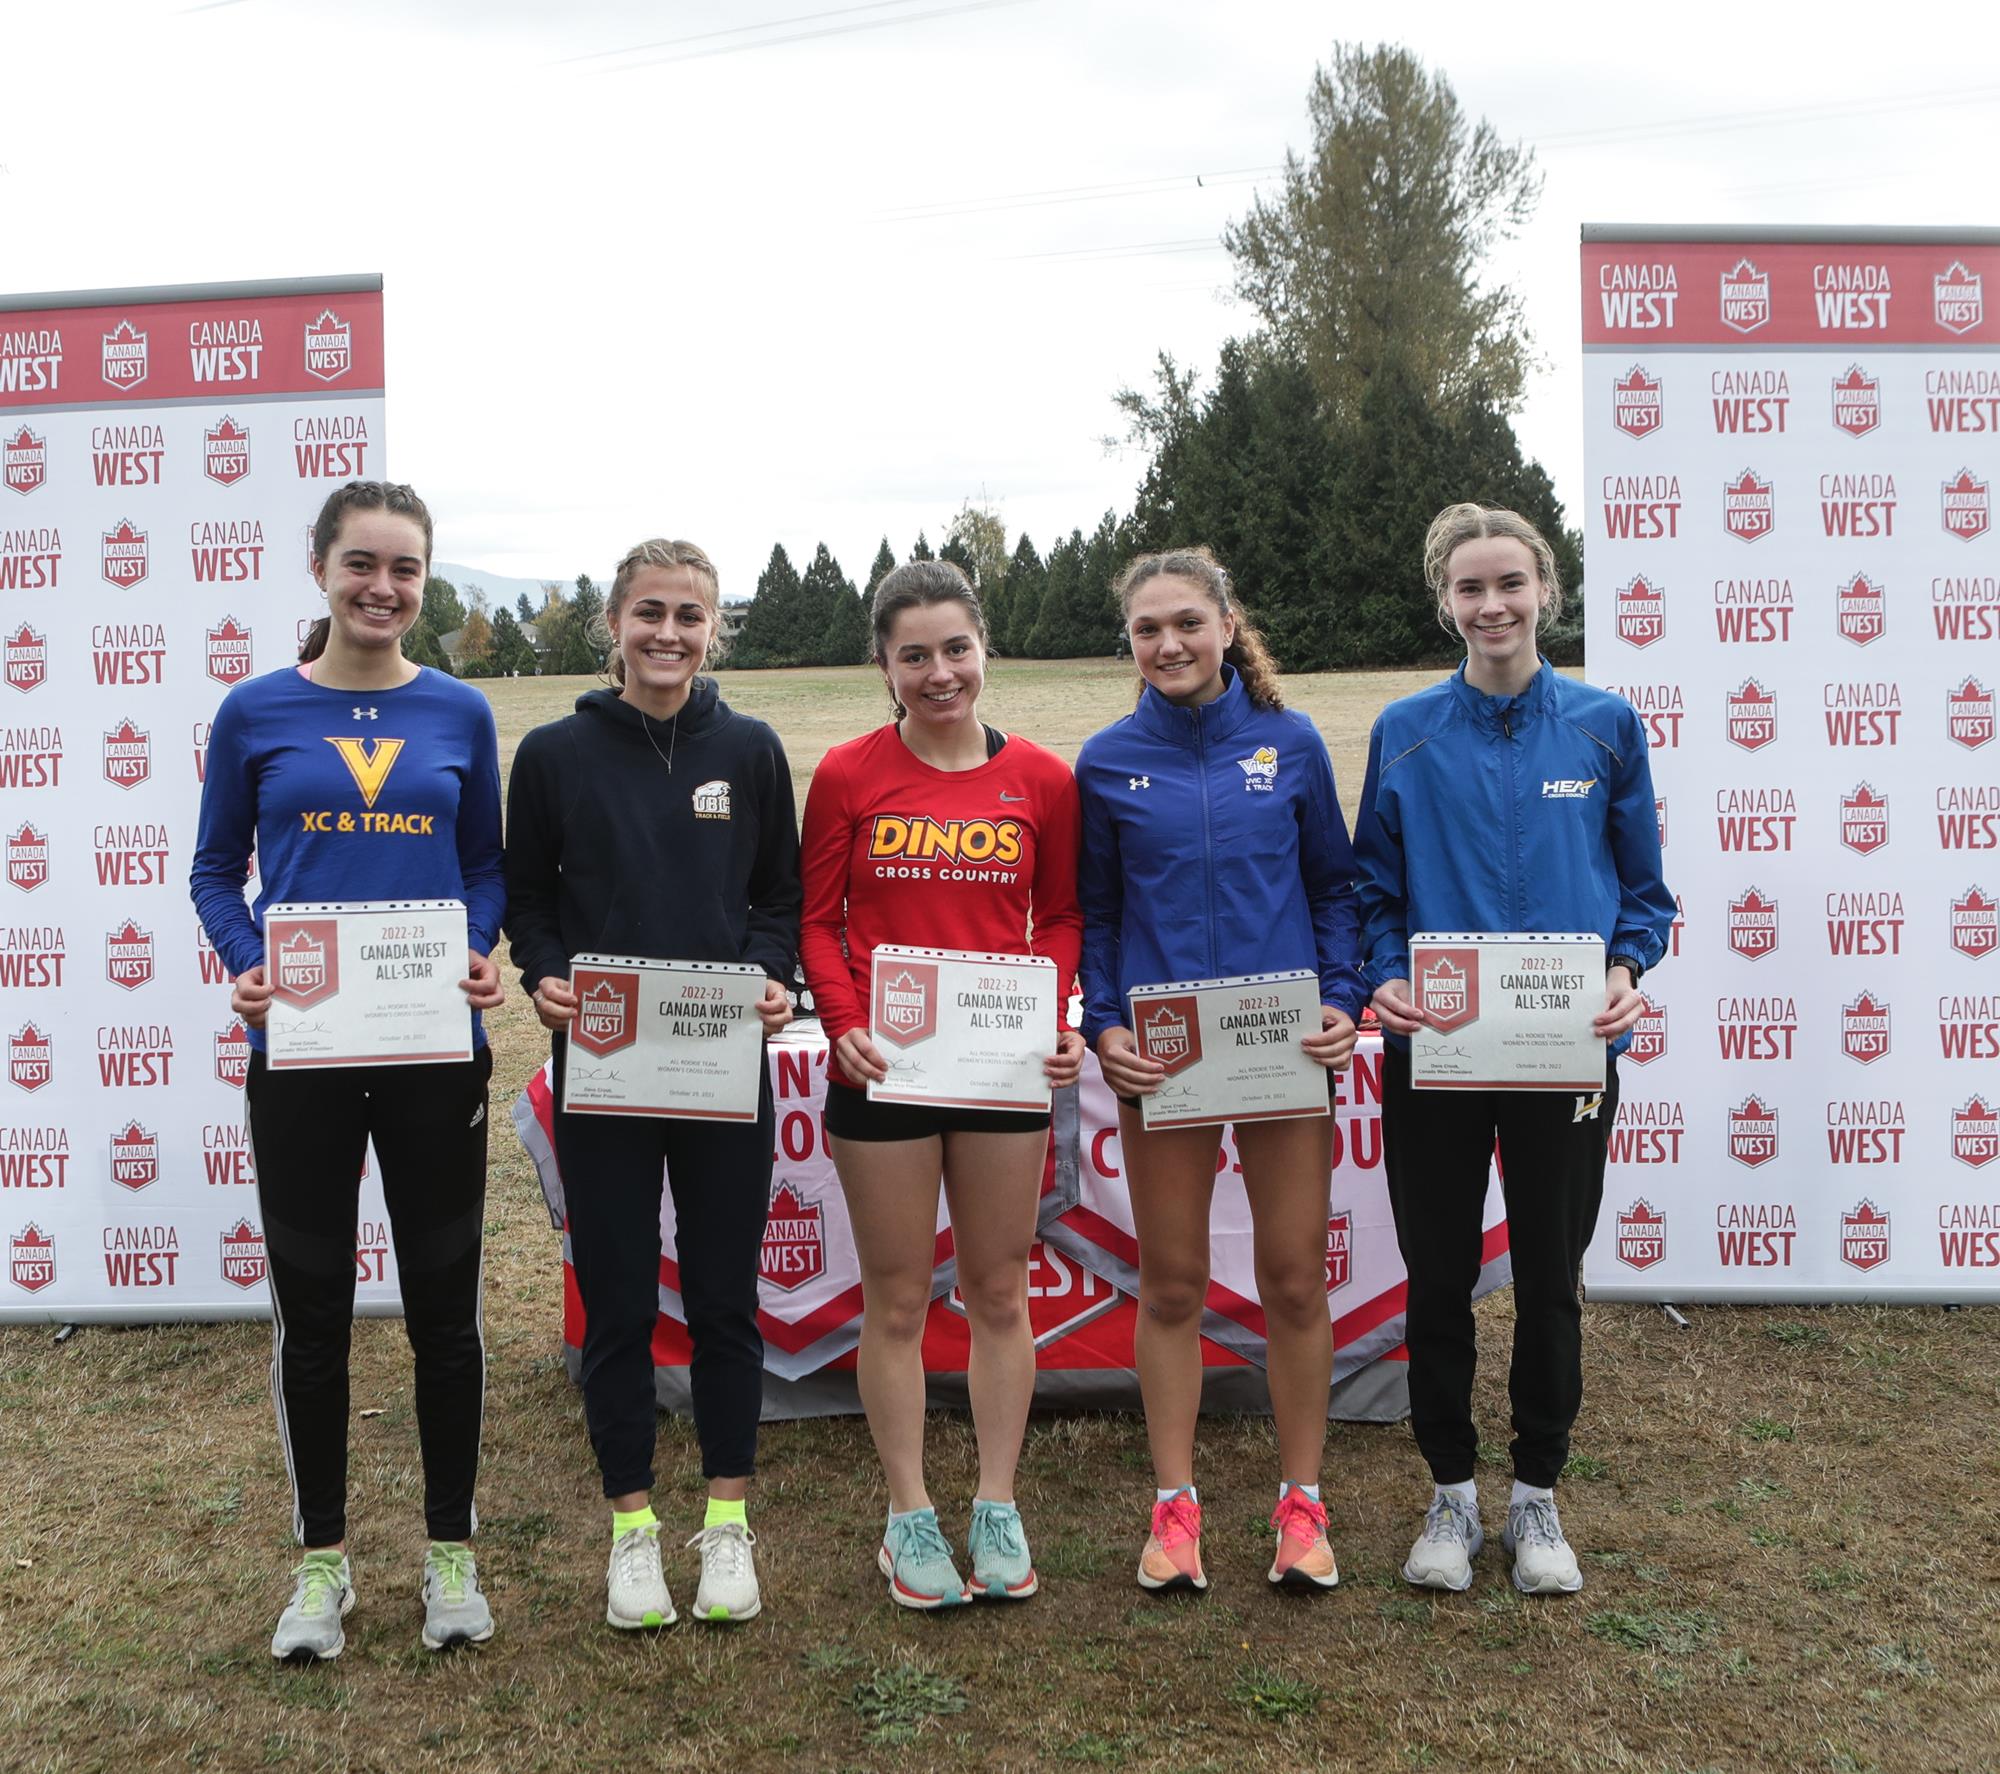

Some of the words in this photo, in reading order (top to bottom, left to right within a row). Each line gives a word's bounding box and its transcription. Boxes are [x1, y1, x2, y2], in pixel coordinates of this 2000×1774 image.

[1600, 264, 1678, 291] CANADA
[1814, 265, 1891, 291] CANADA
[1724, 284, 1765, 298] CANADA
[1938, 284, 1976, 299] CANADA
[1600, 291, 1678, 329] WEST
[1726, 301, 1765, 320] WEST
[1815, 292, 1891, 329] WEST
[1939, 301, 1978, 321] WEST
[0, 329, 62, 356] ANADA
[190, 319, 262, 345] CANADA
[308, 335, 347, 348] CANADA
[106, 344, 143, 358] CANADA
[309, 350, 347, 369] WEST
[0, 356, 62, 392] WEST
[107, 360, 143, 378] WEST
[190, 345, 263, 382] WEST
[1712, 371, 1789, 395] CANADA
[1926, 371, 2000, 394] CANADA
[1713, 398, 1789, 433] WEST
[1928, 398, 2000, 433] WEST
[93, 425, 164, 450] CANADA
[295, 416, 367, 441] CANADA
[93, 450, 164, 486] WEST
[296, 442, 368, 478] WEST
[1604, 476, 1680, 500] CANADA
[1821, 475, 1896, 498] CANADA
[1604, 502, 1680, 539] WEST
[1822, 501, 1895, 537] WEST
[3, 528, 61, 553] ANADA
[191, 520, 263, 545] CANADA
[106, 544, 143, 556] CANADA
[0, 553, 63, 590] WEST
[106, 560, 143, 578] WEST
[192, 546, 263, 582] WEST
[1715, 580, 1793, 604] CANADA
[93, 624, 165, 648] CANADA
[1716, 607, 1793, 642] WEST
[94, 650, 166, 685] WEST
[1825, 683, 1901, 707] CANADA
[1731, 704, 1772, 716] CANADA
[1731, 720, 1772, 738] WEST
[1825, 710, 1901, 746] WEST
[0, 752, 64, 789] WEST
[323, 737, 406, 809] V
[1542, 778, 1597, 795] HEAT
[692, 795, 730, 814] UBC
[1717, 789, 1796, 813] CANADA
[302, 811, 332, 832] XC
[337, 812, 355, 832] &
[360, 812, 434, 835] TRACK
[95, 825, 168, 848] CANADA
[868, 815, 1023, 866] DINOS
[1718, 817, 1797, 853] WEST
[10, 847, 45, 859] CANADA
[10, 863, 45, 881] WEST
[95, 850, 169, 886] WEST
[875, 867, 931, 879] CROSS
[939, 868, 1017, 884] COUNTRY
[1827, 892, 1904, 917] CANADA
[382, 926, 425, 939] 2022-23
[1826, 920, 1905, 956] WEST
[284, 953, 321, 964] CANADA
[361, 944, 410, 960] CANADA
[413, 942, 447, 958] WEST
[0, 952, 65, 988] WEST
[285, 967, 320, 984] WEST
[376, 963, 433, 980] ALL-STAR
[1521, 958, 1562, 970] 2022-23
[681, 985, 724, 1000] 2022-23
[978, 977, 1017, 992] 2022-23
[1427, 979, 1462, 990] CANADA
[1500, 975, 1547, 989] CANADA
[1551, 975, 1584, 989] WEST
[585, 1002, 621, 1014] CANADA
[887, 992, 922, 1004] CANADA
[958, 993, 1002, 1010] CANADA
[1006, 996, 1038, 1011] WEST
[1239, 996, 1280, 1010] 2022-23
[1428, 993, 1462, 1009] WEST
[1515, 995, 1570, 1010] ALL-STAR
[1718, 998, 1797, 1021] CANADA
[659, 1002, 706, 1018] CANADA
[710, 1004, 744, 1019] WEST
[888, 1006, 921, 1024] WEST
[970, 1013, 1023, 1030] ALL-STAR
[1220, 1014, 1266, 1030] CANADA
[1269, 1009, 1301, 1024] WEST
[586, 1015, 620, 1032] WEST
[672, 1021, 727, 1038] ALL-STAR
[1150, 1026, 1183, 1038] CANADA
[98, 1026, 173, 1050] CANADA
[1151, 1038, 1184, 1055] WEST
[1236, 1029, 1288, 1046] ALL-STAR
[1718, 1024, 1797, 1061] WEST
[99, 1052, 173, 1088] WEST
[1613, 1102, 1684, 1126] ANADA
[1827, 1101, 1904, 1125] CANADA
[1733, 1121, 1774, 1133] CANADA
[0, 1128, 69, 1151] CANADA
[1606, 1128, 1685, 1164] WEST
[1733, 1137, 1774, 1155] WEST
[1827, 1127, 1905, 1164] WEST
[0, 1153, 69, 1189] WEST
[1717, 1205, 1796, 1228] CANADA
[104, 1226, 178, 1250] CANADA
[762, 1221, 817, 1240] ANADA
[761, 1245, 817, 1273] WEST
[1718, 1231, 1797, 1266] WEST
[105, 1252, 178, 1287] WEST
